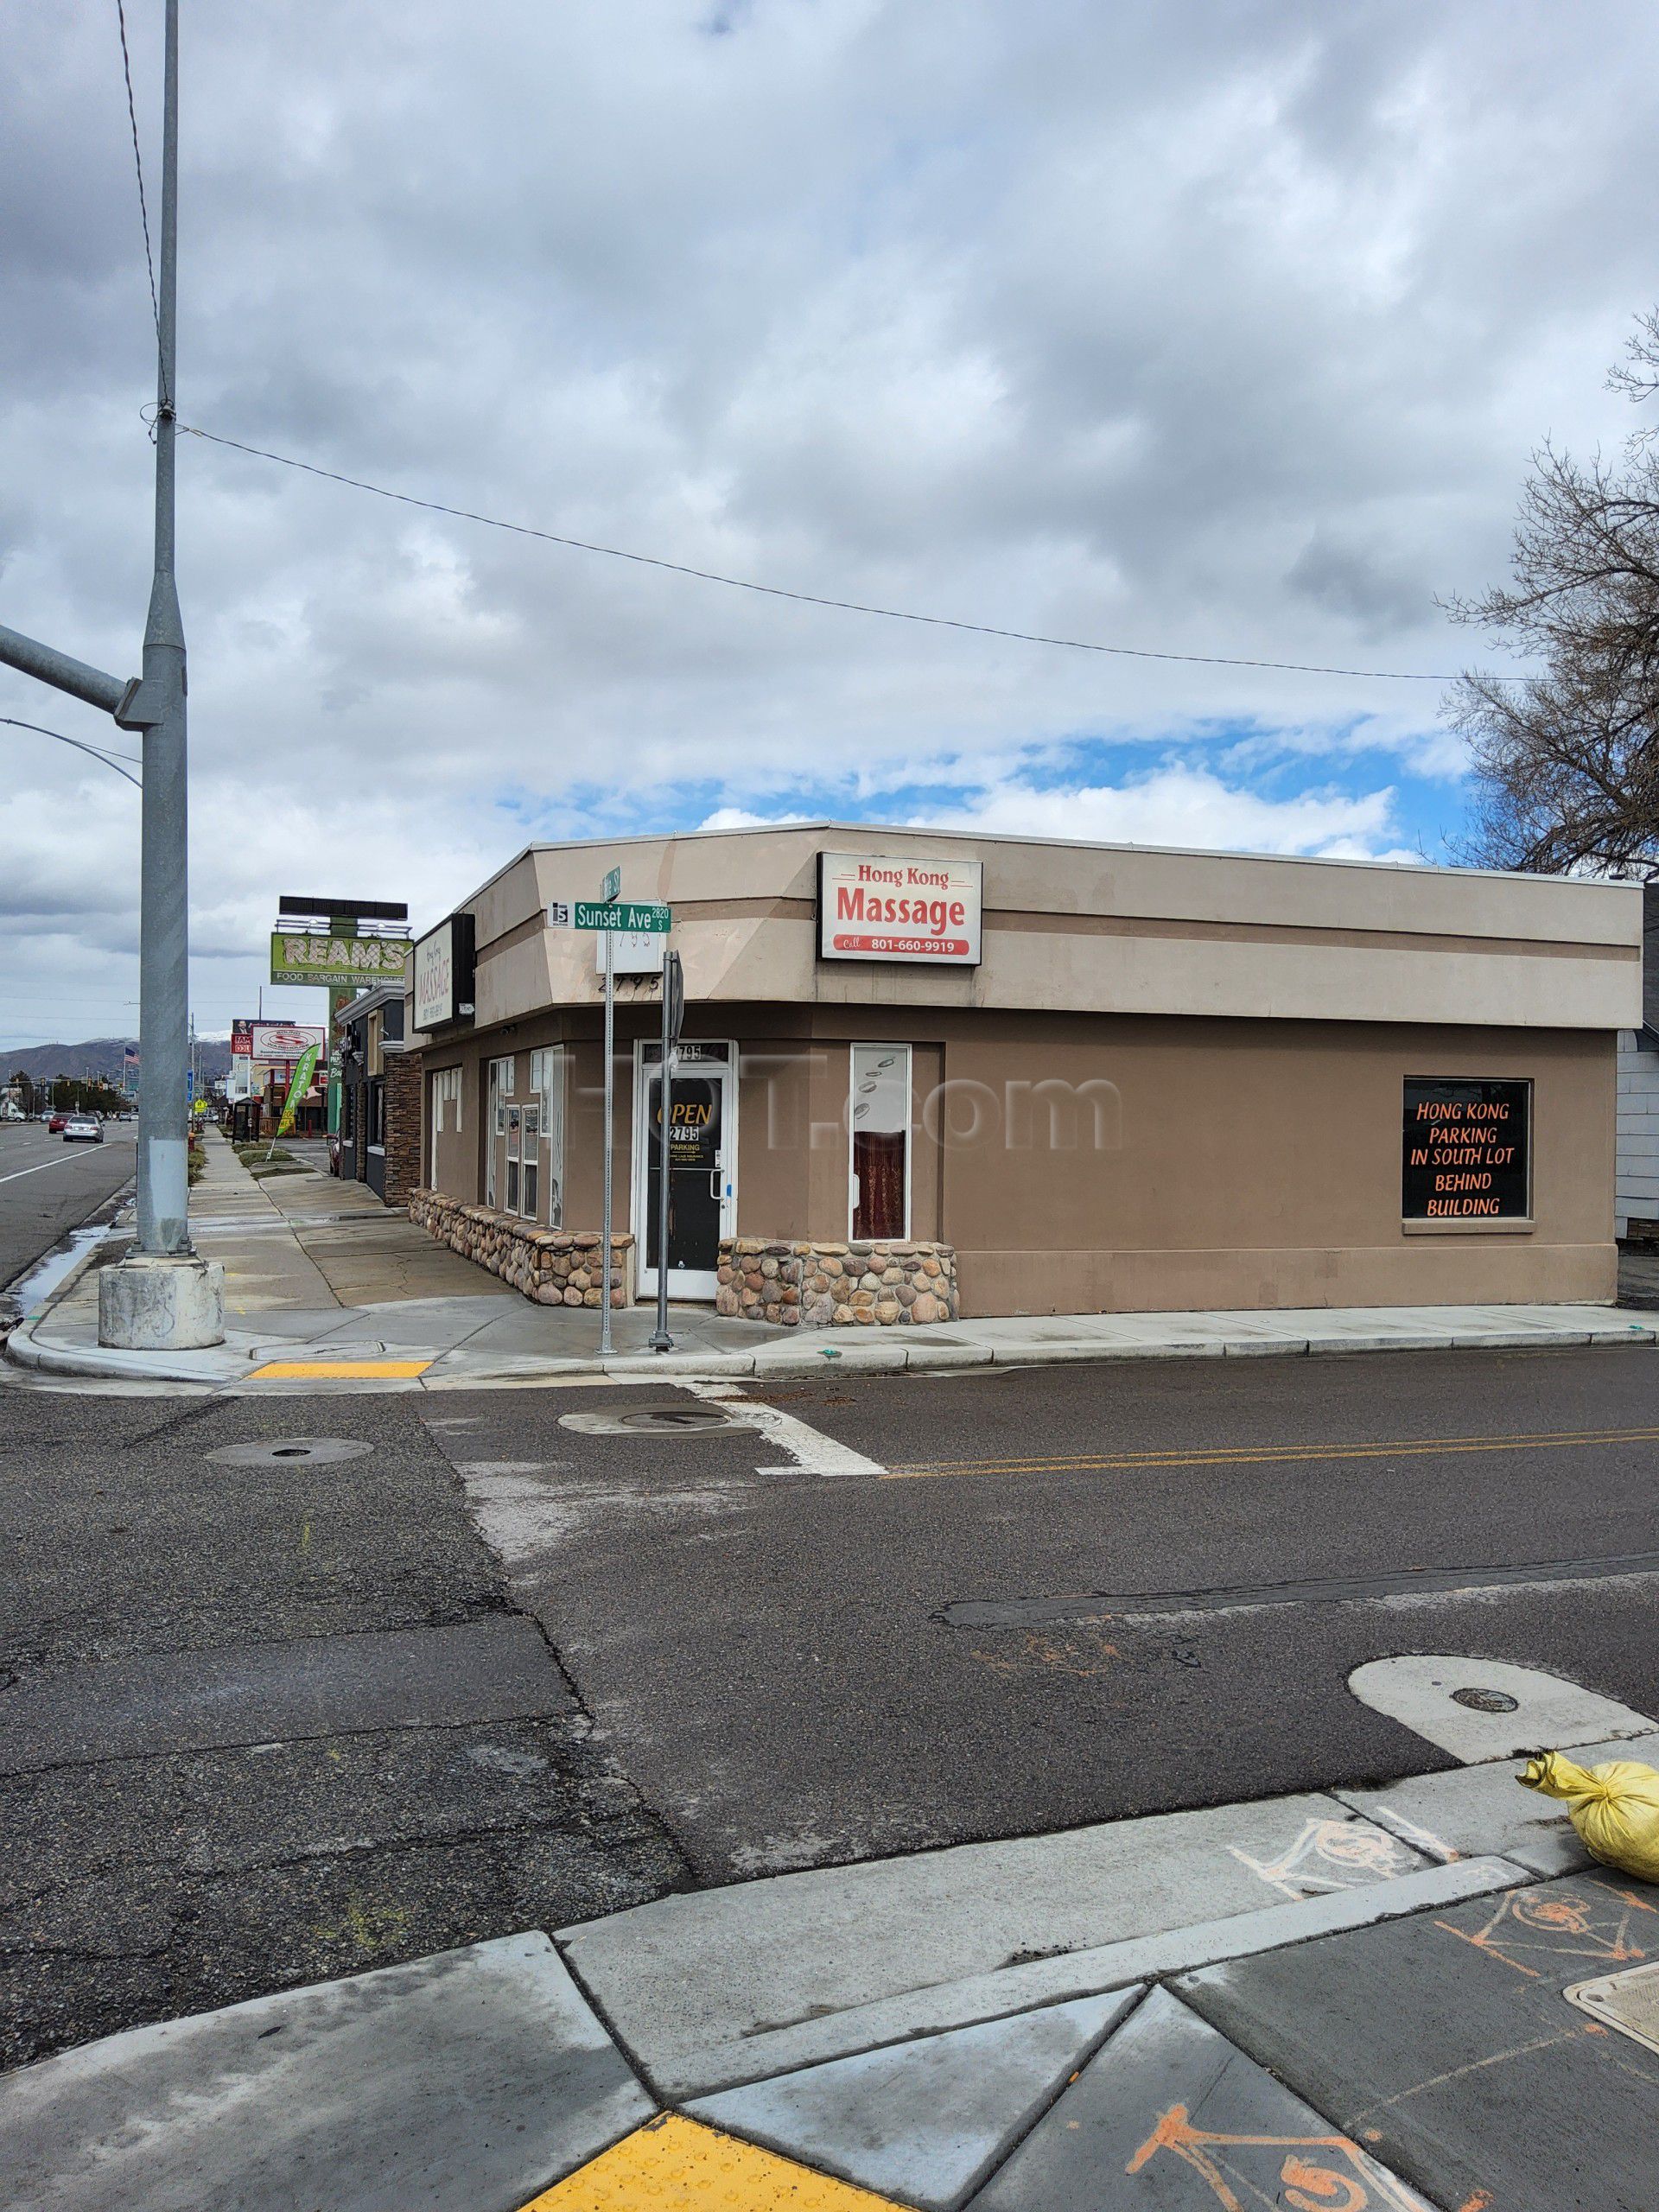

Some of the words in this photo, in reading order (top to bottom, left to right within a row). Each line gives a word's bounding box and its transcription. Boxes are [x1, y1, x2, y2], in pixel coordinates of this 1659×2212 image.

[858, 865, 903, 887] Hong
[906, 868, 950, 890] Kong
[577, 904, 622, 927] Sunset
[627, 907, 652, 929] Ave
[652, 907, 669, 919] 2820
[837, 887, 965, 936] Massage
[658, 919, 663, 931] S
[283, 938, 405, 969] REAM'S
[843, 938, 861, 949] Call
[871, 938, 955, 952] 801-660-9919
[276, 972, 303, 982] FOOD
[308, 974, 347, 983] BARGAIN
[678, 1046, 700, 1060] 795
[657, 1103, 712, 1124] OPEN
[1417, 1102, 1462, 1120] HONG
[1466, 1103, 1510, 1119] KONG
[670, 1127, 698, 1141] 2795
[1429, 1127, 1497, 1144] PARKING
[1410, 1148, 1428, 1165] IN
[1432, 1147, 1483, 1166] SOUTH
[1486, 1147, 1515, 1164] LOT
[1435, 1173, 1492, 1192] BEHIND
[1427, 1198, 1500, 1217] BUILDING
